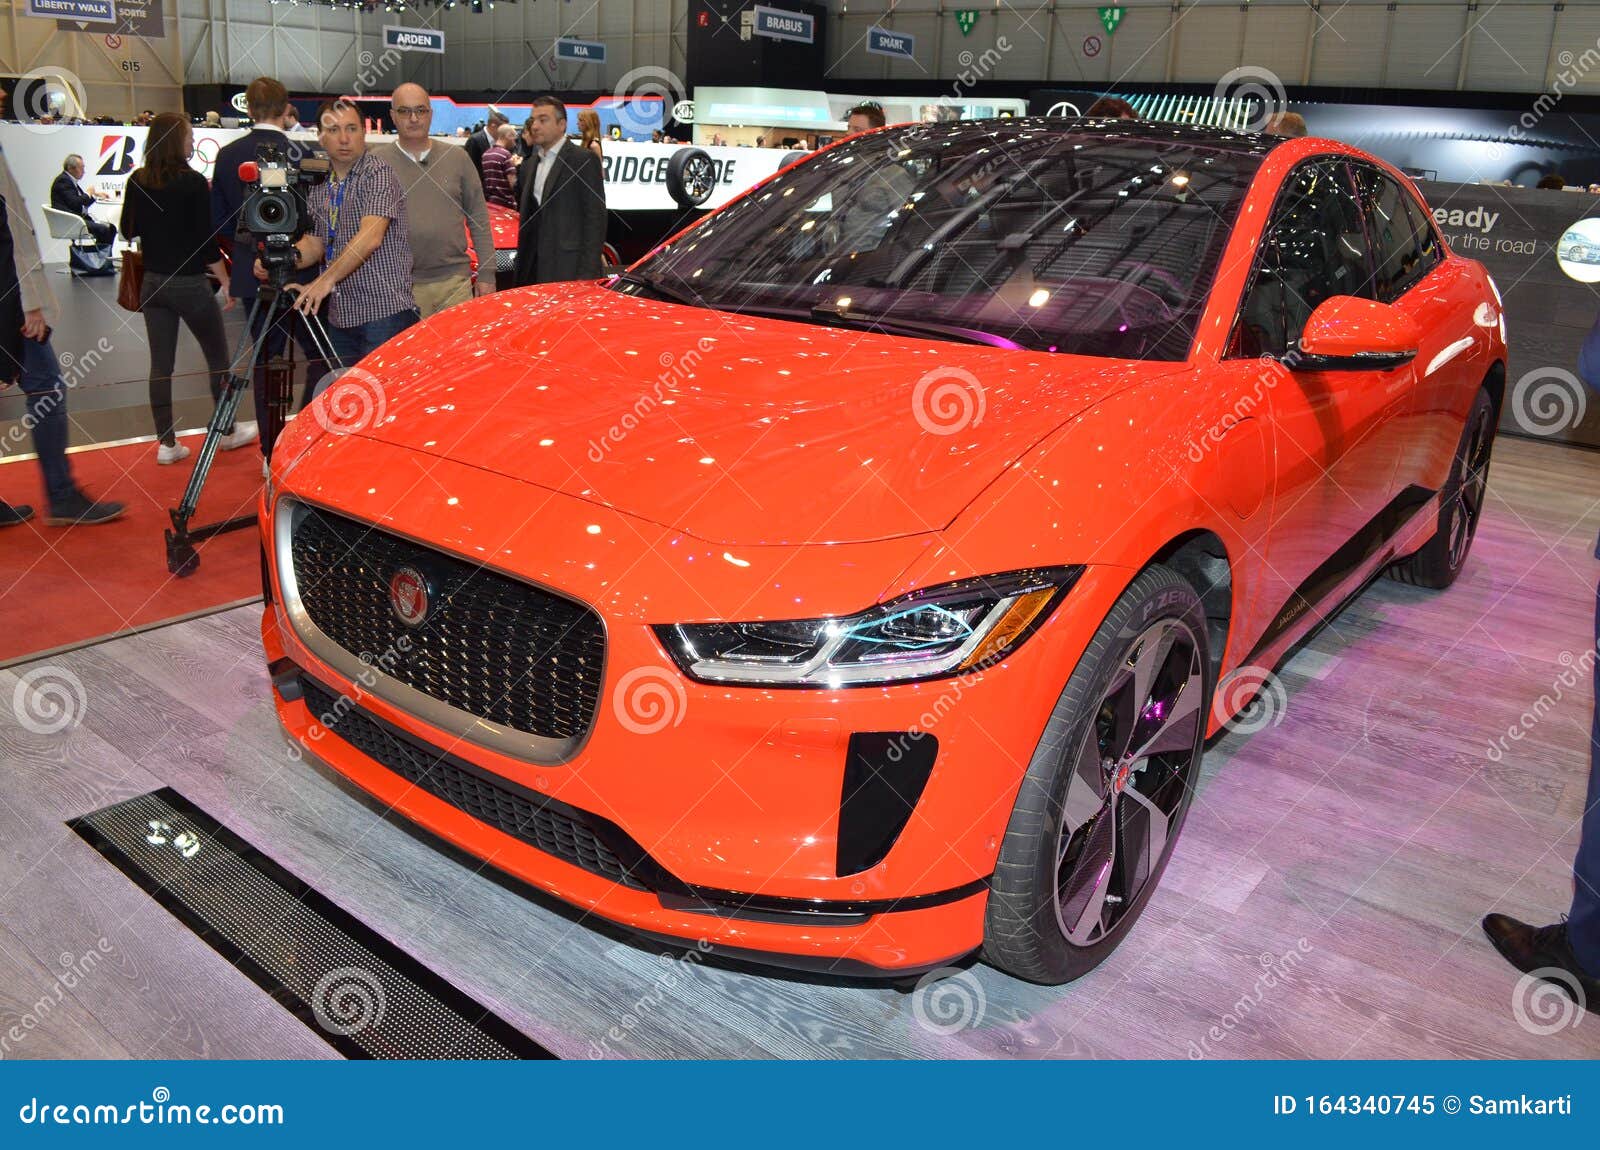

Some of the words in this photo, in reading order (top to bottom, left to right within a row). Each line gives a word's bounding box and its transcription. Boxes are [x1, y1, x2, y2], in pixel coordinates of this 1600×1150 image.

[35, 0, 76, 11] LIBERTY
[78, 4, 107, 14] WALK
[766, 16, 803, 33] BRABUS
[397, 33, 432, 46] ARDEN
[879, 36, 905, 50] SMART
[573, 45, 589, 57] KIA
[122, 61, 141, 72] 615
[101, 182, 125, 190] Worl
[1429, 206, 1500, 233] eady
[1443, 233, 1459, 248] or
[1463, 233, 1490, 250] the
[1495, 239, 1537, 255] road
